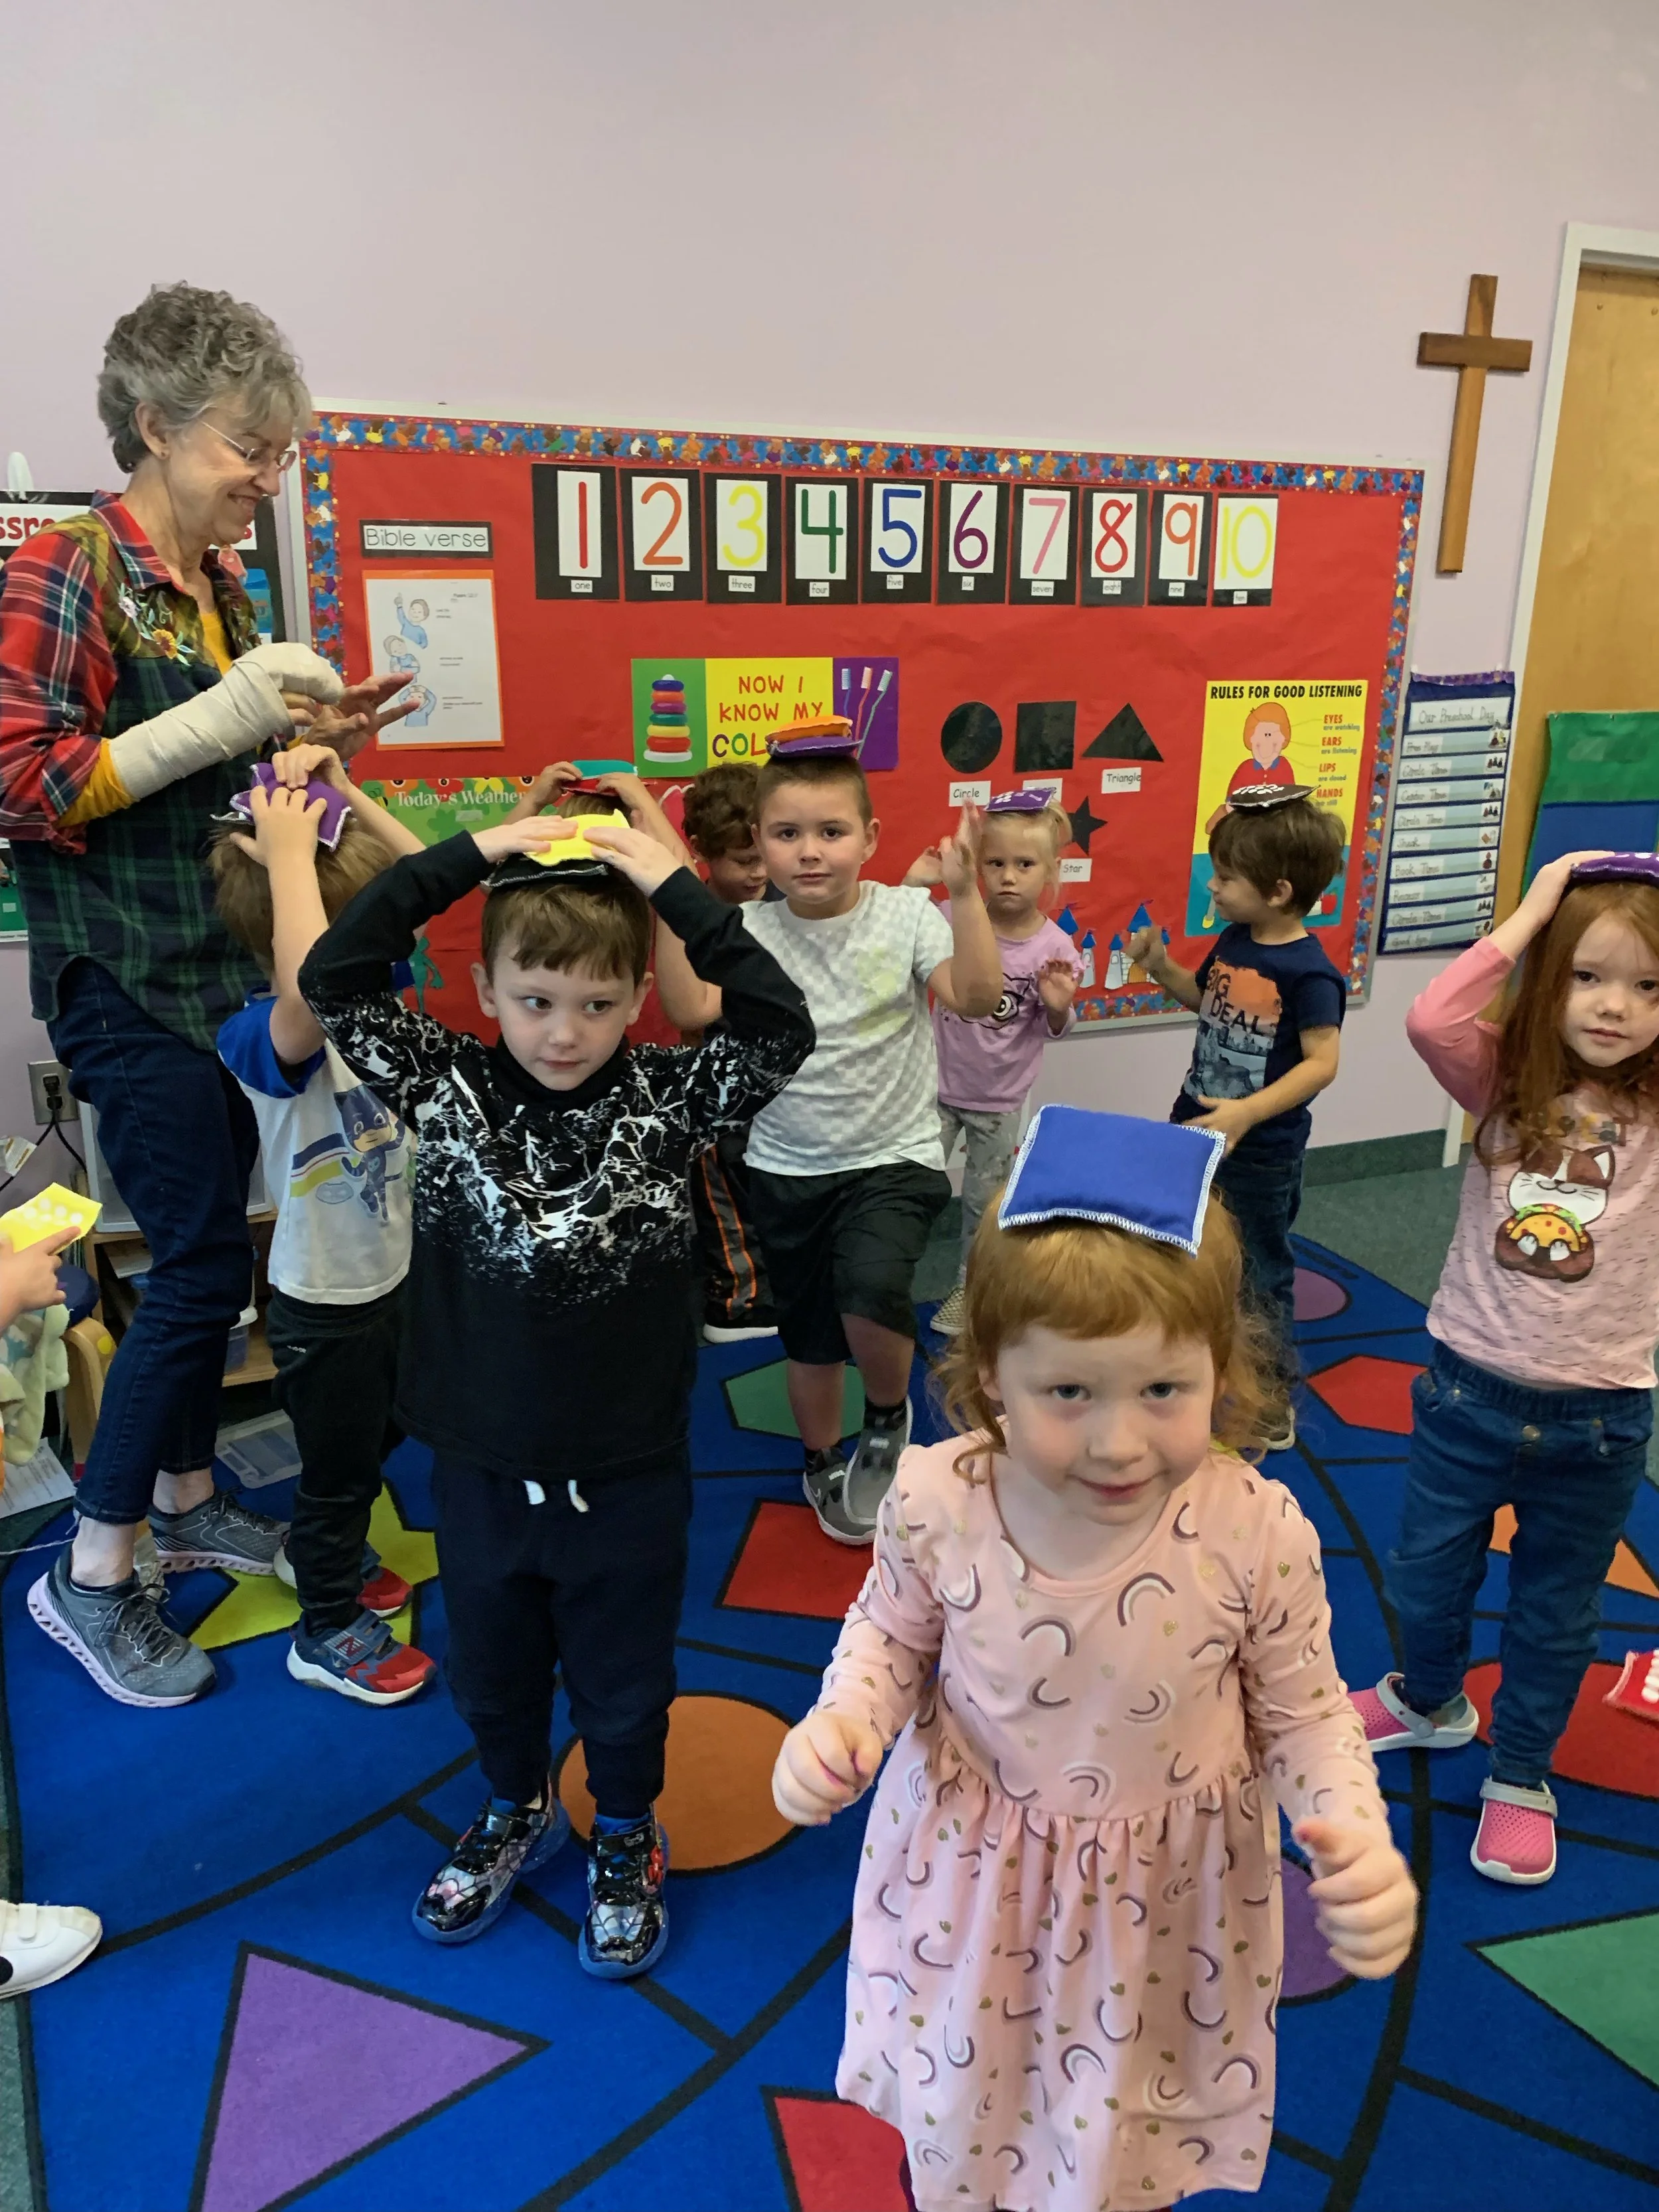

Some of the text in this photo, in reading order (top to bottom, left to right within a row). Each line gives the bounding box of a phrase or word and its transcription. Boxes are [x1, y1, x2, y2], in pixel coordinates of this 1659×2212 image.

[578, 481, 588, 569] 1
[641, 481, 684, 565] 2
[722, 484, 764, 567] 3
[801, 488, 844, 573] 4
[878, 488, 922, 567] 5
[954, 490, 988, 569] 6
[366, 528, 486, 547] Bible verse
[1029, 498, 1066, 574] 7
[1095, 499, 1133, 573] 8
[1165, 502, 1198, 576] 9
[1220, 505, 1273, 579] 10
[574, 581, 591, 590] one
[654, 577, 672, 589] two
[731, 578, 752, 589] three
[812, 584, 828, 595] four
[887, 576, 903, 587] five
[963, 579, 972, 587] six
[1104, 583, 1121, 593] eight
[739, 675, 804, 694] NOW I
[1210, 685, 1362, 699] RULES FOR GOOD LISTENING
[793, 701, 823, 721] MY
[1324, 714, 1342, 723] EYES
[1419, 709, 1436, 724] Our
[1479, 706, 1495, 724] Day
[1322, 737, 1342, 746] EARS
[1319, 763, 1336, 773] LIPS
[1107, 773, 1141, 784] Triangle
[395, 790, 526, 807] Today's Weather
[953, 788, 979, 798] Circle
[1316, 788, 1343, 798] HANDS
[1063, 864, 1083, 873] Star
[1206, 968, 1231, 999] BIG
[1210, 995, 1265, 1036] DEAL
